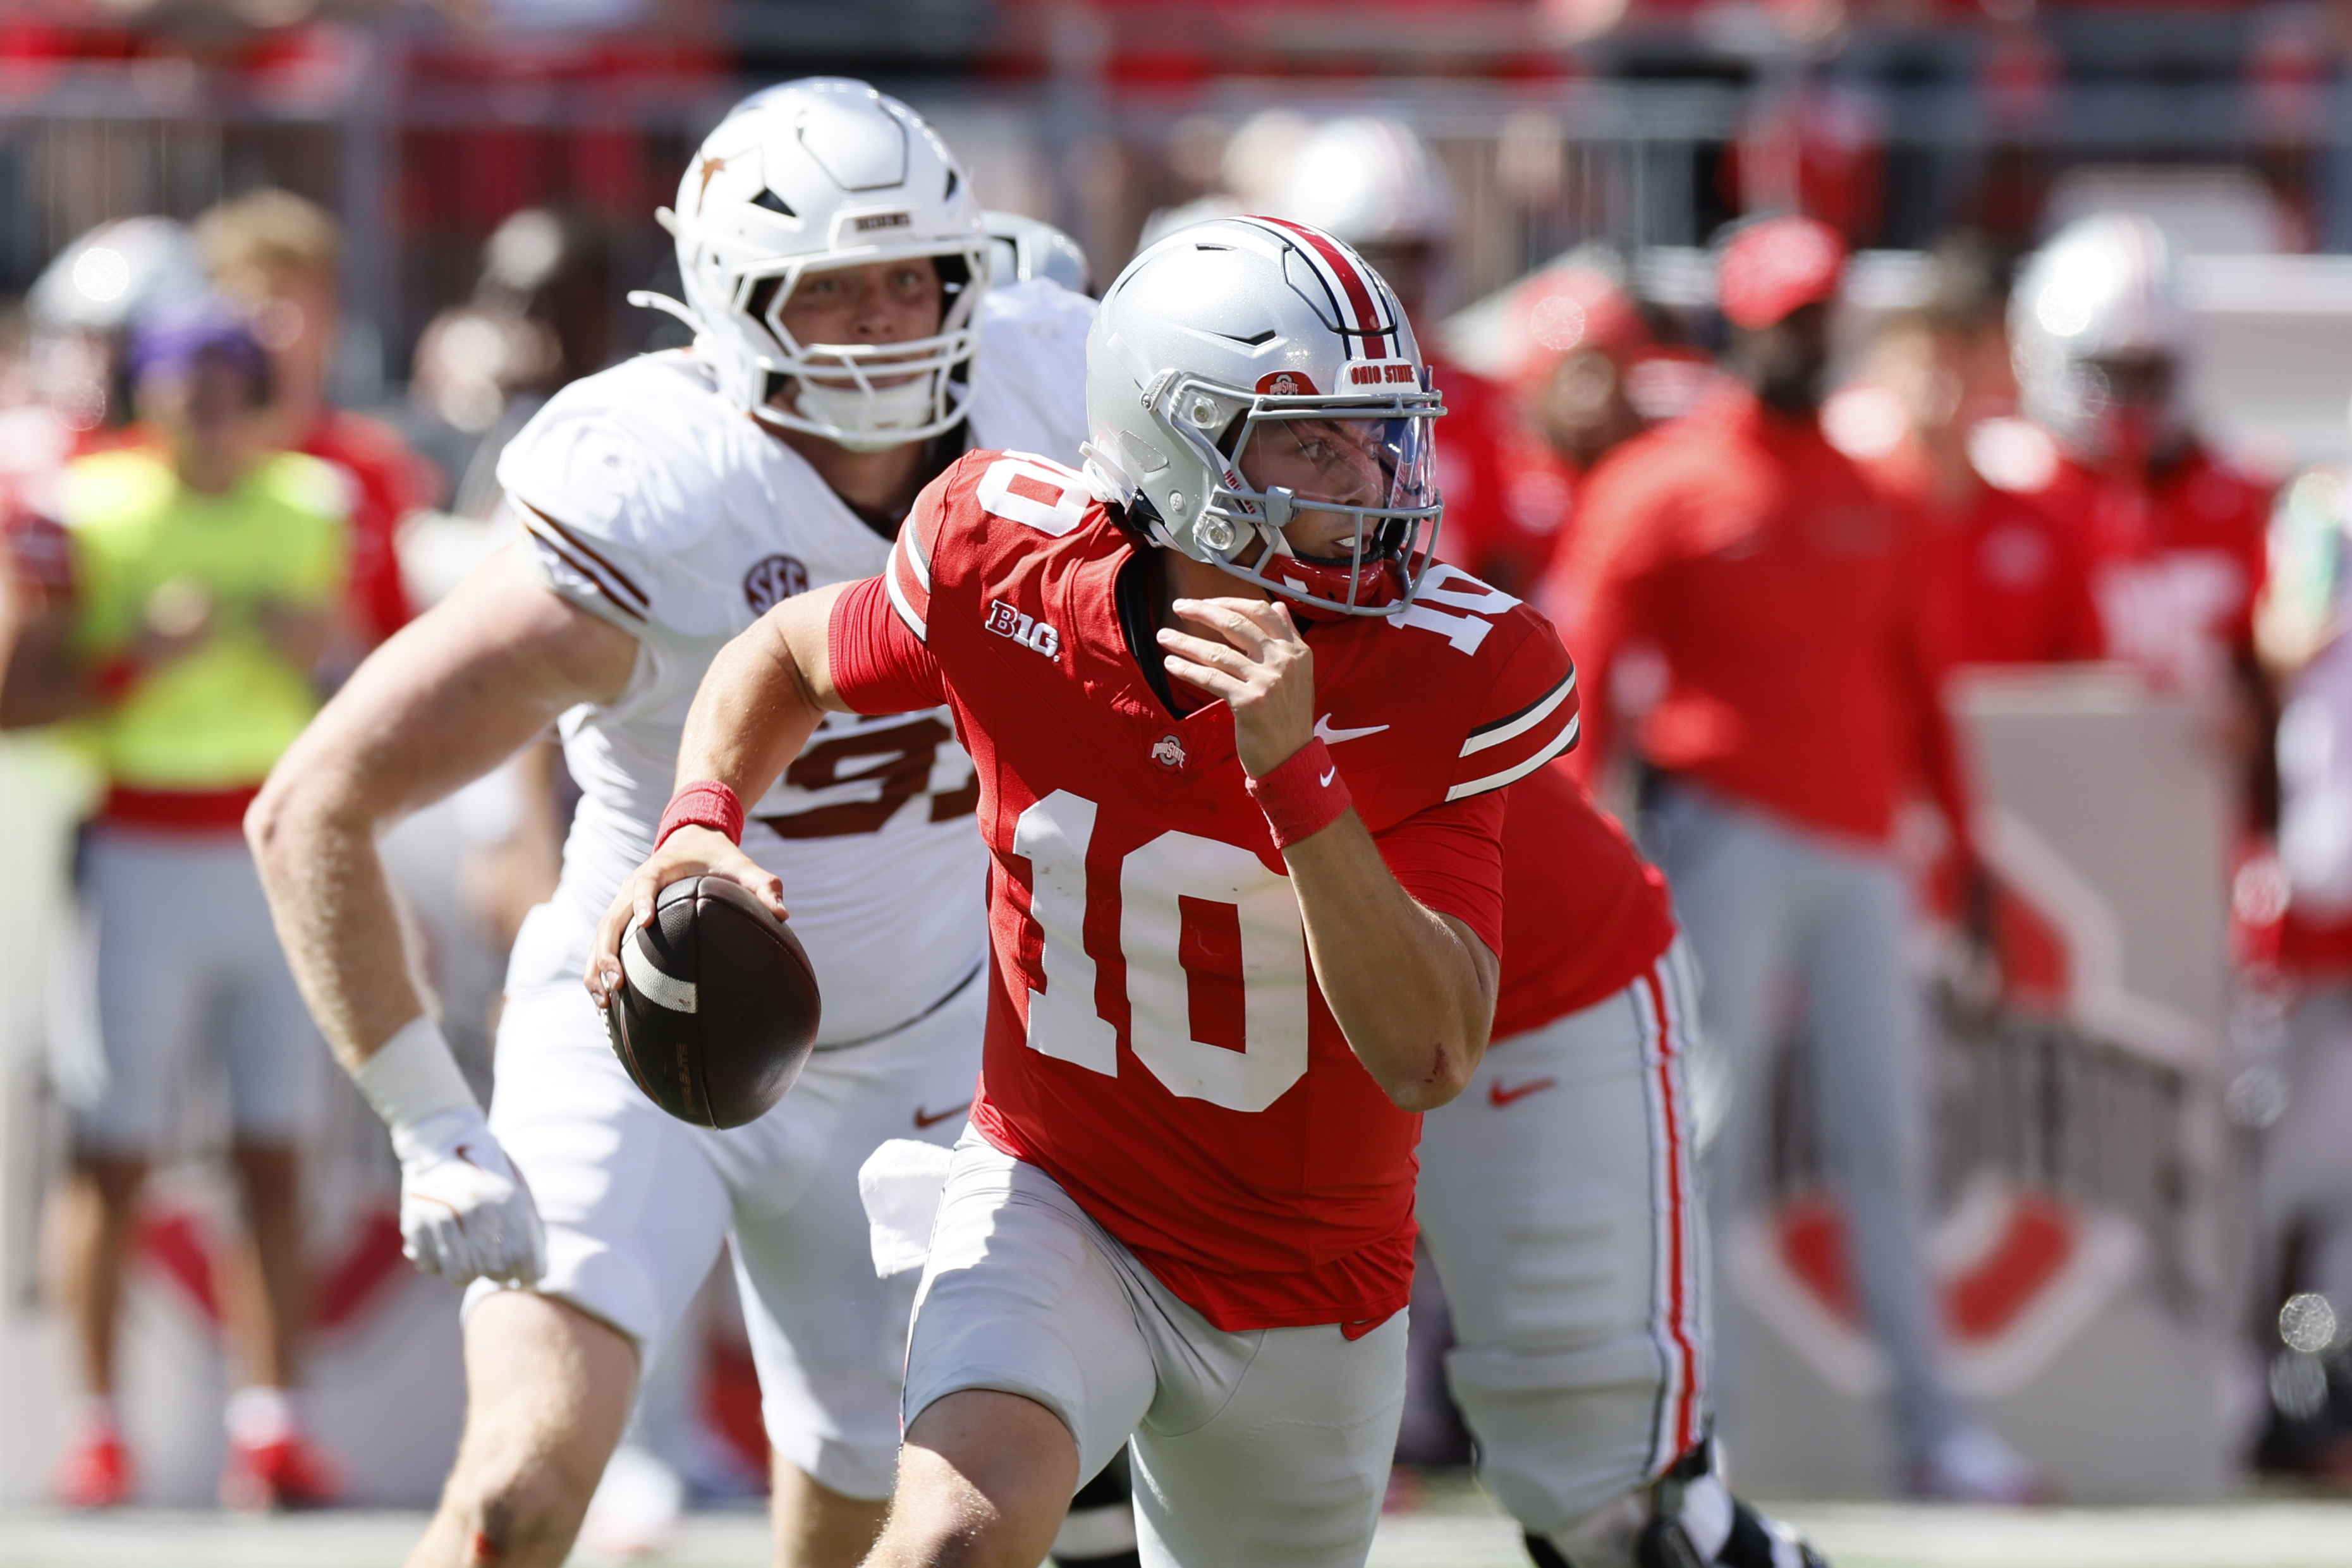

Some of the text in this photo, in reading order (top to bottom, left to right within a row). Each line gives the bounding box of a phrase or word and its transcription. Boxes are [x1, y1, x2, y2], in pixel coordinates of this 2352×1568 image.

[1269, 380, 1299, 395] OHIO STATE
[1350, 364, 1415, 385] OHIO STATE
[1386, 563, 1523, 657] 10
[1151, 742, 1186, 769] OHIO STATE
[1013, 788, 1309, 1112] 10
